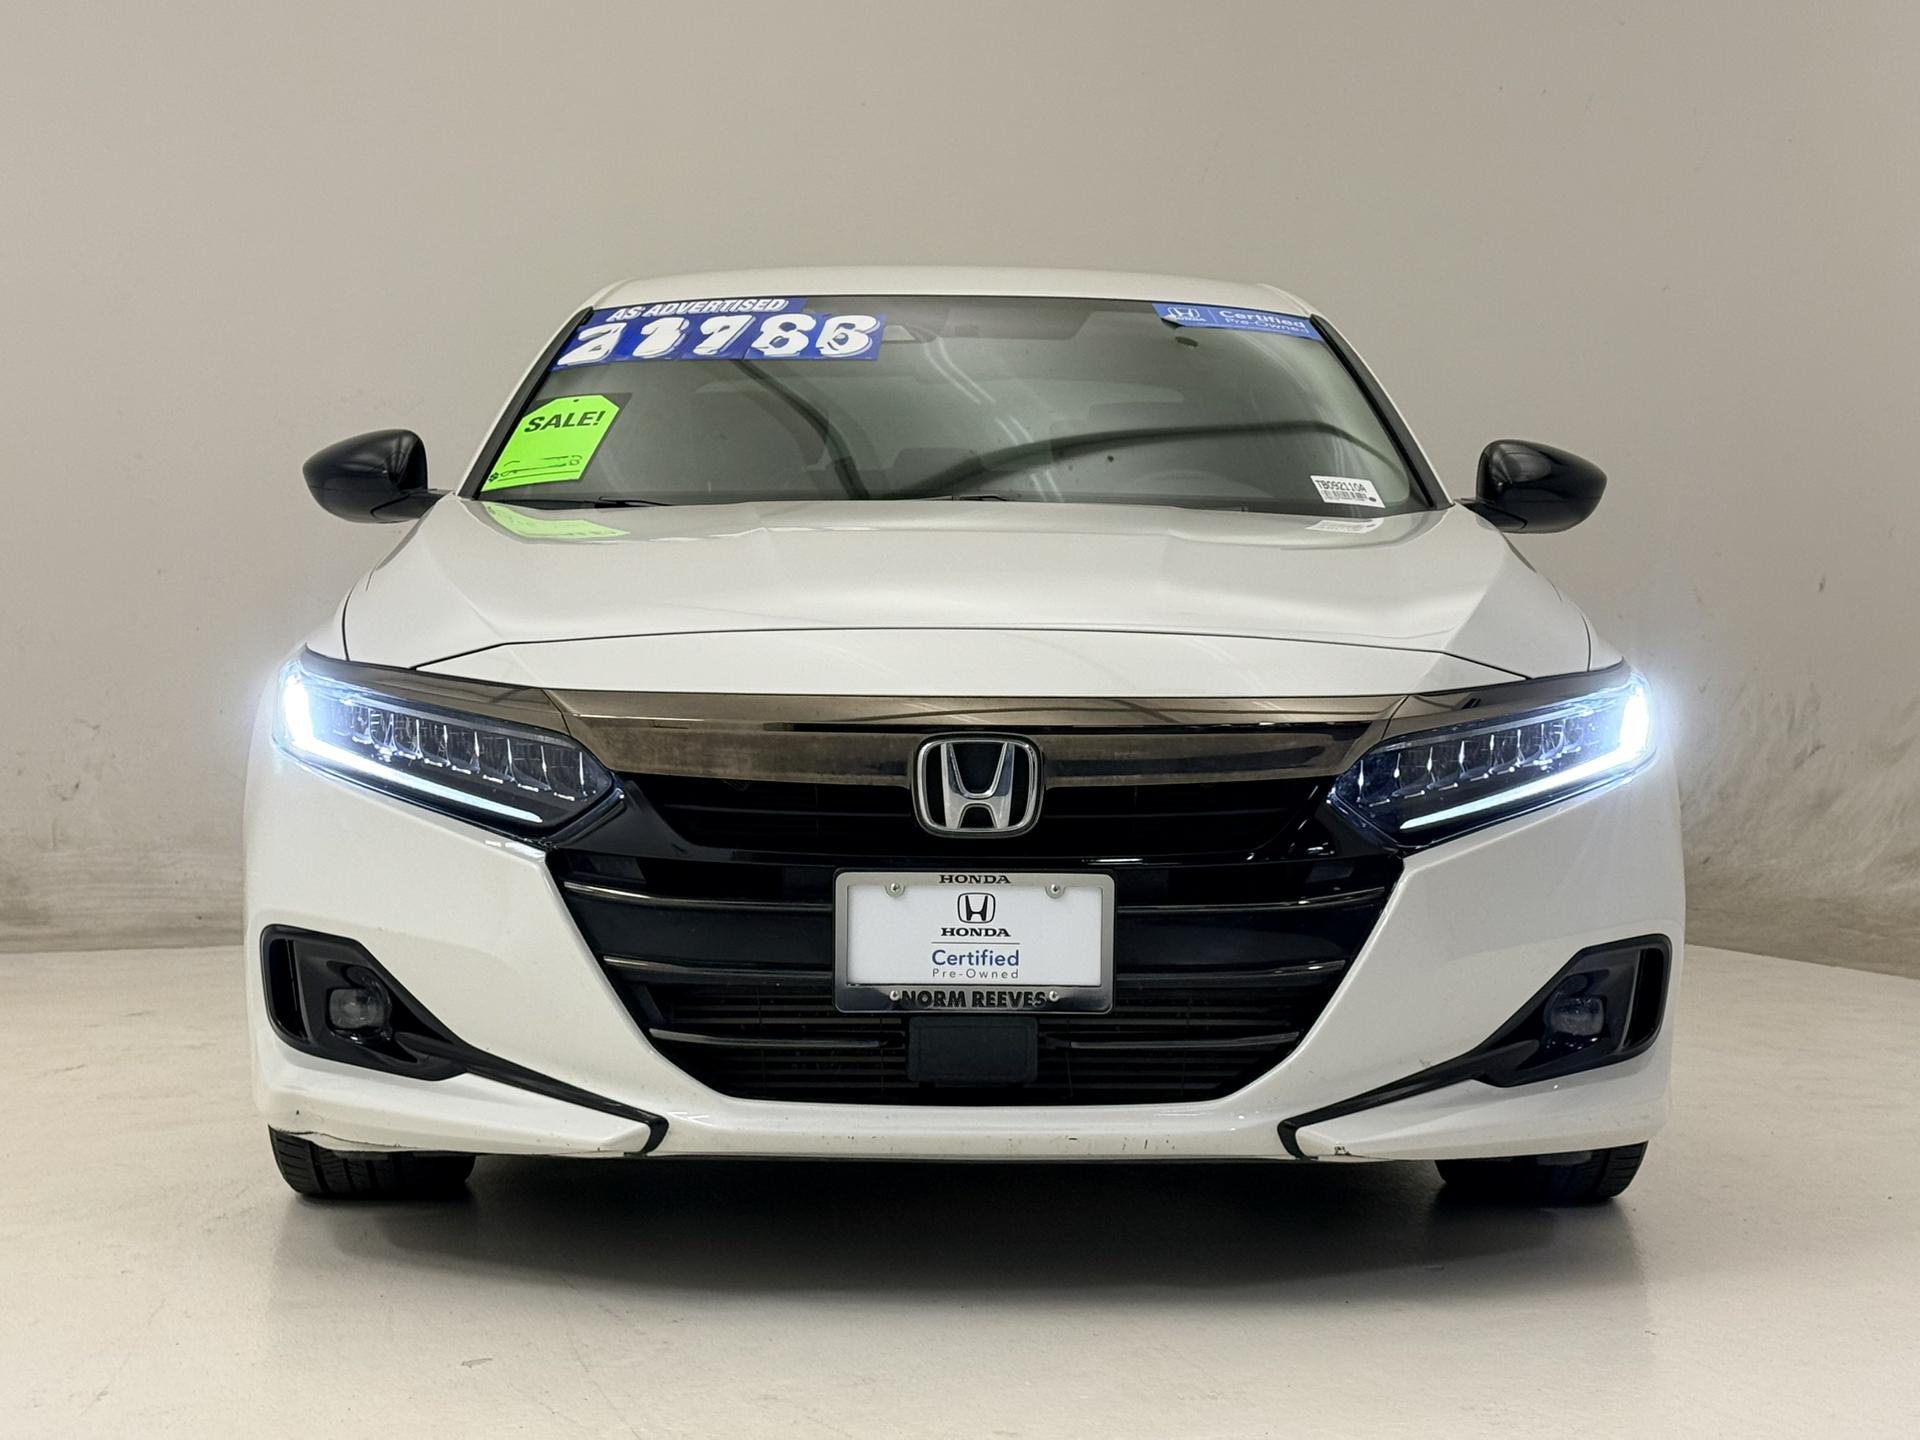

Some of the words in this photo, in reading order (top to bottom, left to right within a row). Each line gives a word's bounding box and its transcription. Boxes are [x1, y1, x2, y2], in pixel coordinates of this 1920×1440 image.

[606, 306, 645, 322] AS
[642, 297, 789, 317] ADVERTISED
[1219, 310, 1306, 329] Certified
[1225, 317, 1310, 334] Pre-Owned
[524, 410, 606, 432] SALE!
[939, 874, 1011, 885] HONDA
[940, 926, 1011, 938] HONDA
[931, 949, 1020, 967] Certified
[932, 967, 1019, 980] Pre-Owned
[902, 990, 968, 1008] NORM
[971, 990, 1047, 1009] REEVES
